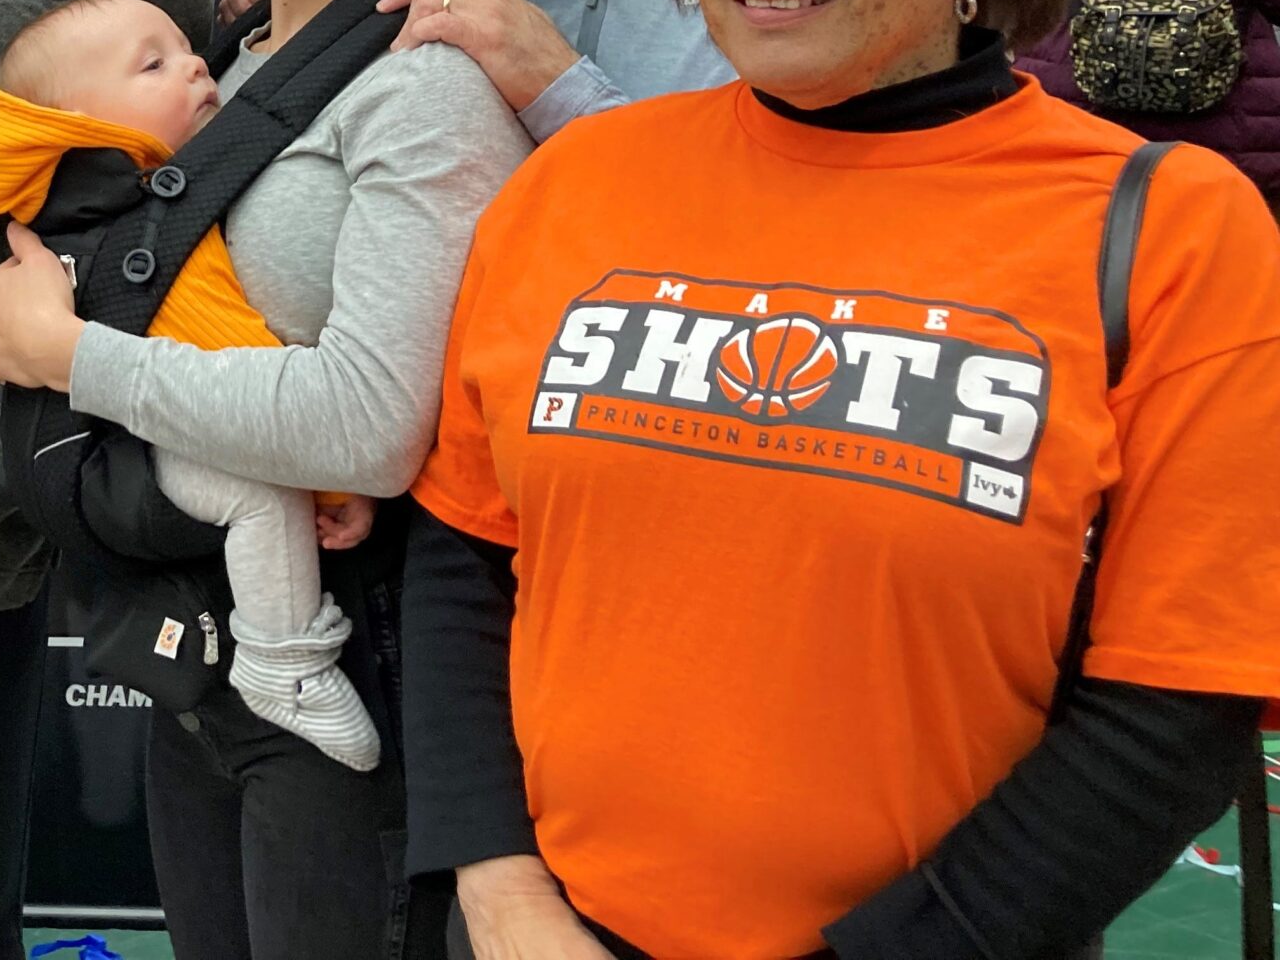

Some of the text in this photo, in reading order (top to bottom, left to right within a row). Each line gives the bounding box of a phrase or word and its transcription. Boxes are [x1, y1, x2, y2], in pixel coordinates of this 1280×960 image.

[654, 280, 951, 332] MAKE
[543, 305, 1043, 462] SHOTS
[586, 403, 950, 483] PRINCETON BASKETBALL
[972, 474, 1002, 497] Ivy
